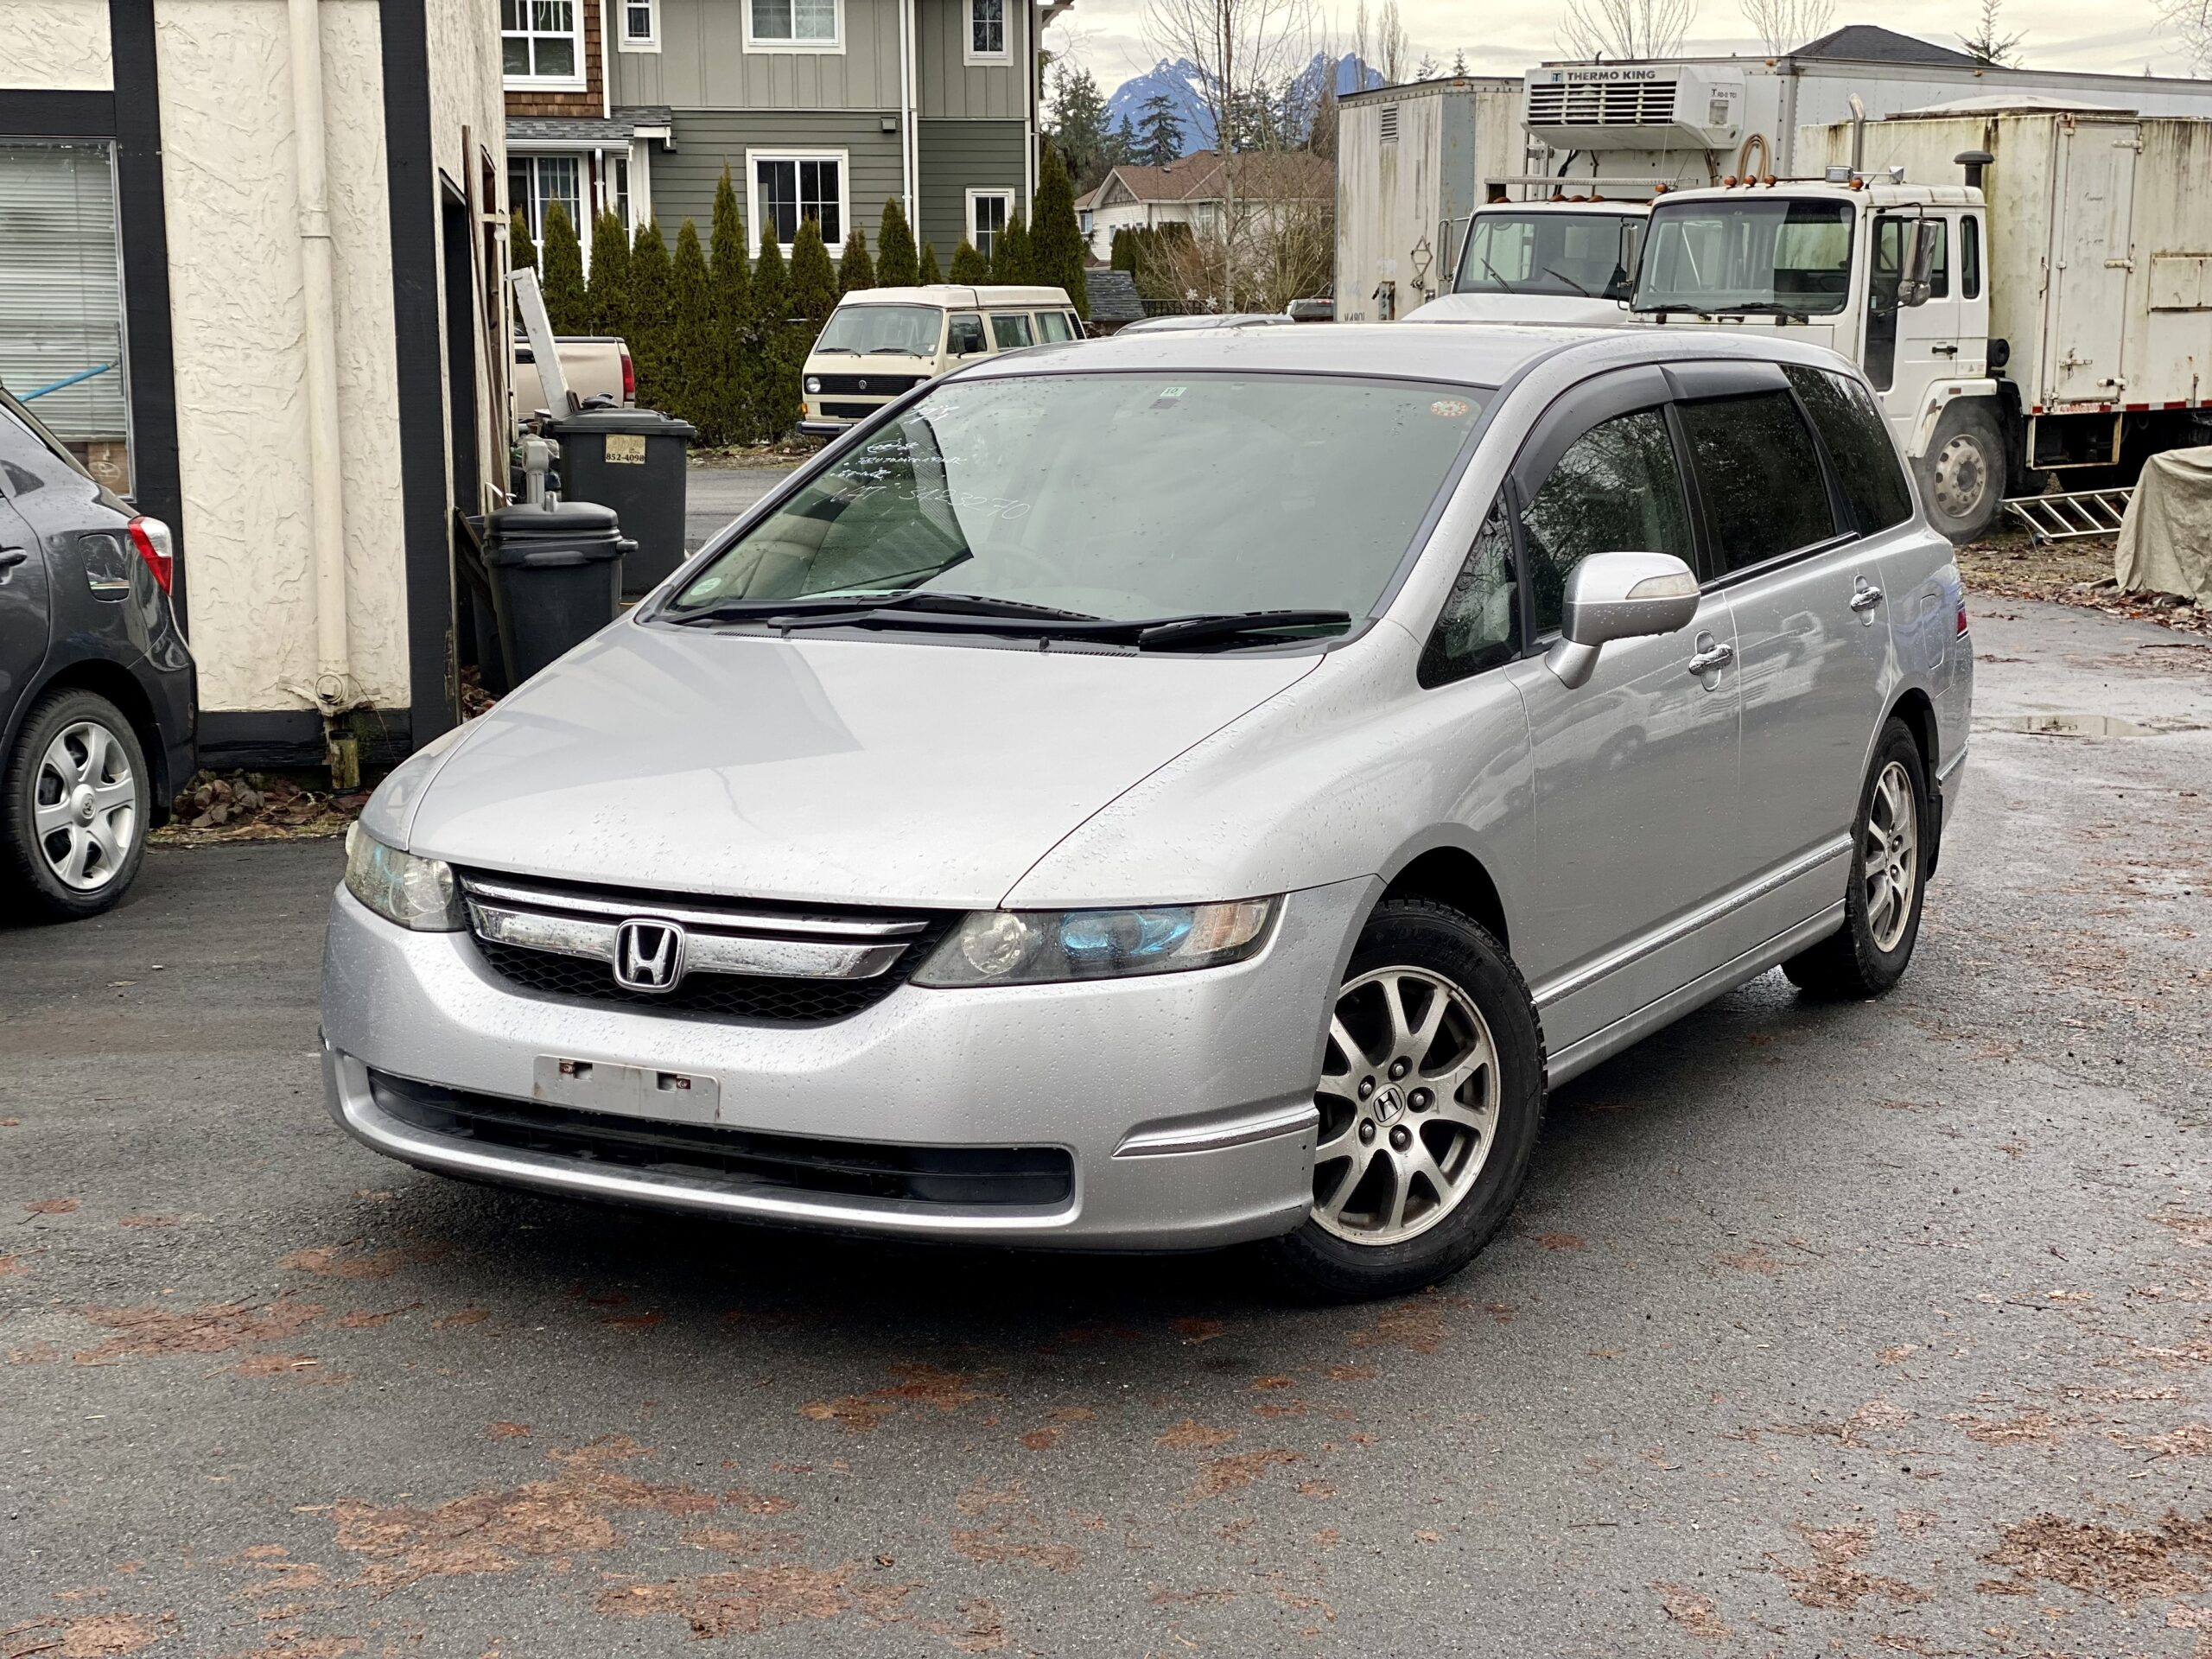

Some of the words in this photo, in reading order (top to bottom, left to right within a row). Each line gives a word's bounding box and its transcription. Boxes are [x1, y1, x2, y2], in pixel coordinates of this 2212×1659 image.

[1567, 72, 1619, 81] THERMO
[1623, 71, 1656, 79] KING
[606, 453, 645, 461] 852-4098
